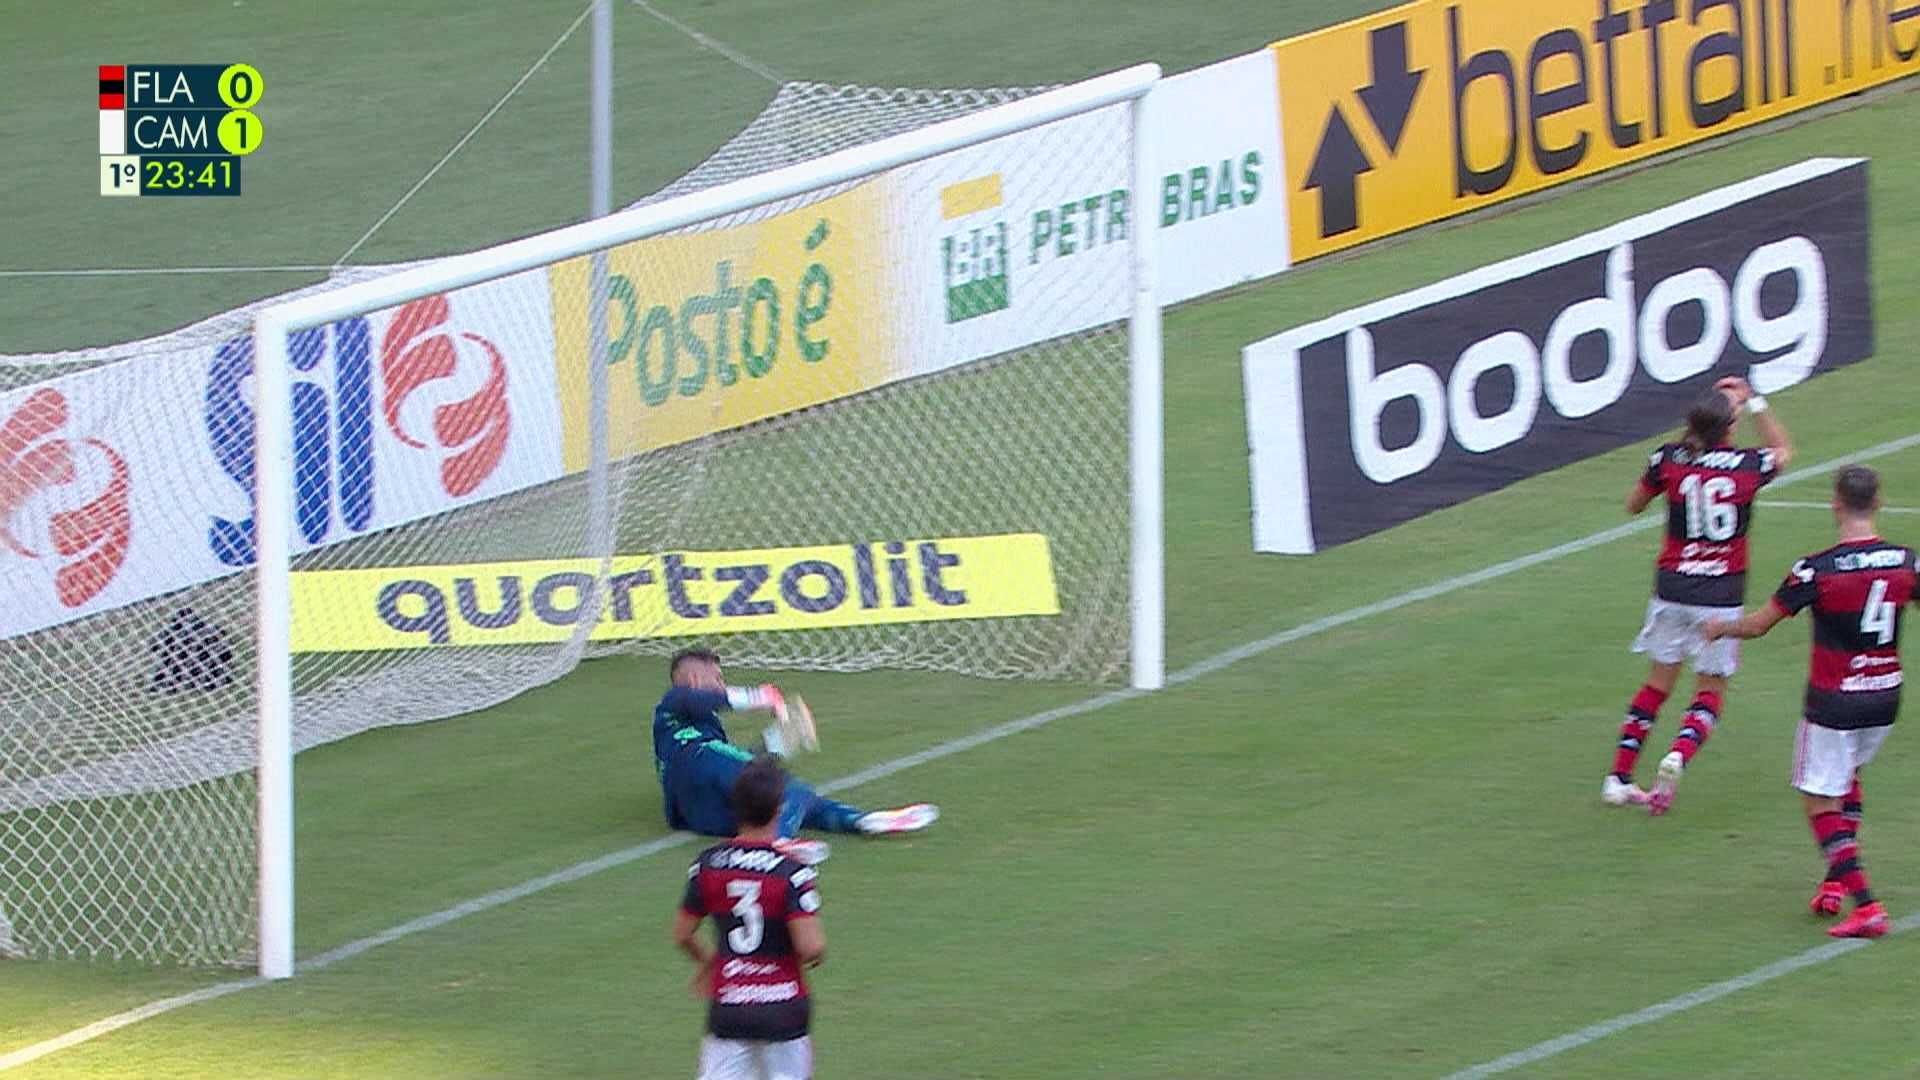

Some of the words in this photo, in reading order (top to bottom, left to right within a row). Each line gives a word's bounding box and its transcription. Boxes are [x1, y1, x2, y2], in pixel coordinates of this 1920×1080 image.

[1027, 150, 1262, 265] PETRBRAS
[795, 217, 831, 363] é
[1345, 234, 1829, 484] bodog
[1678, 473, 1738, 541] 16
[376, 541, 968, 645] quartzolit
[1860, 578, 1896, 645] 4
[726, 879, 764, 955] 3
